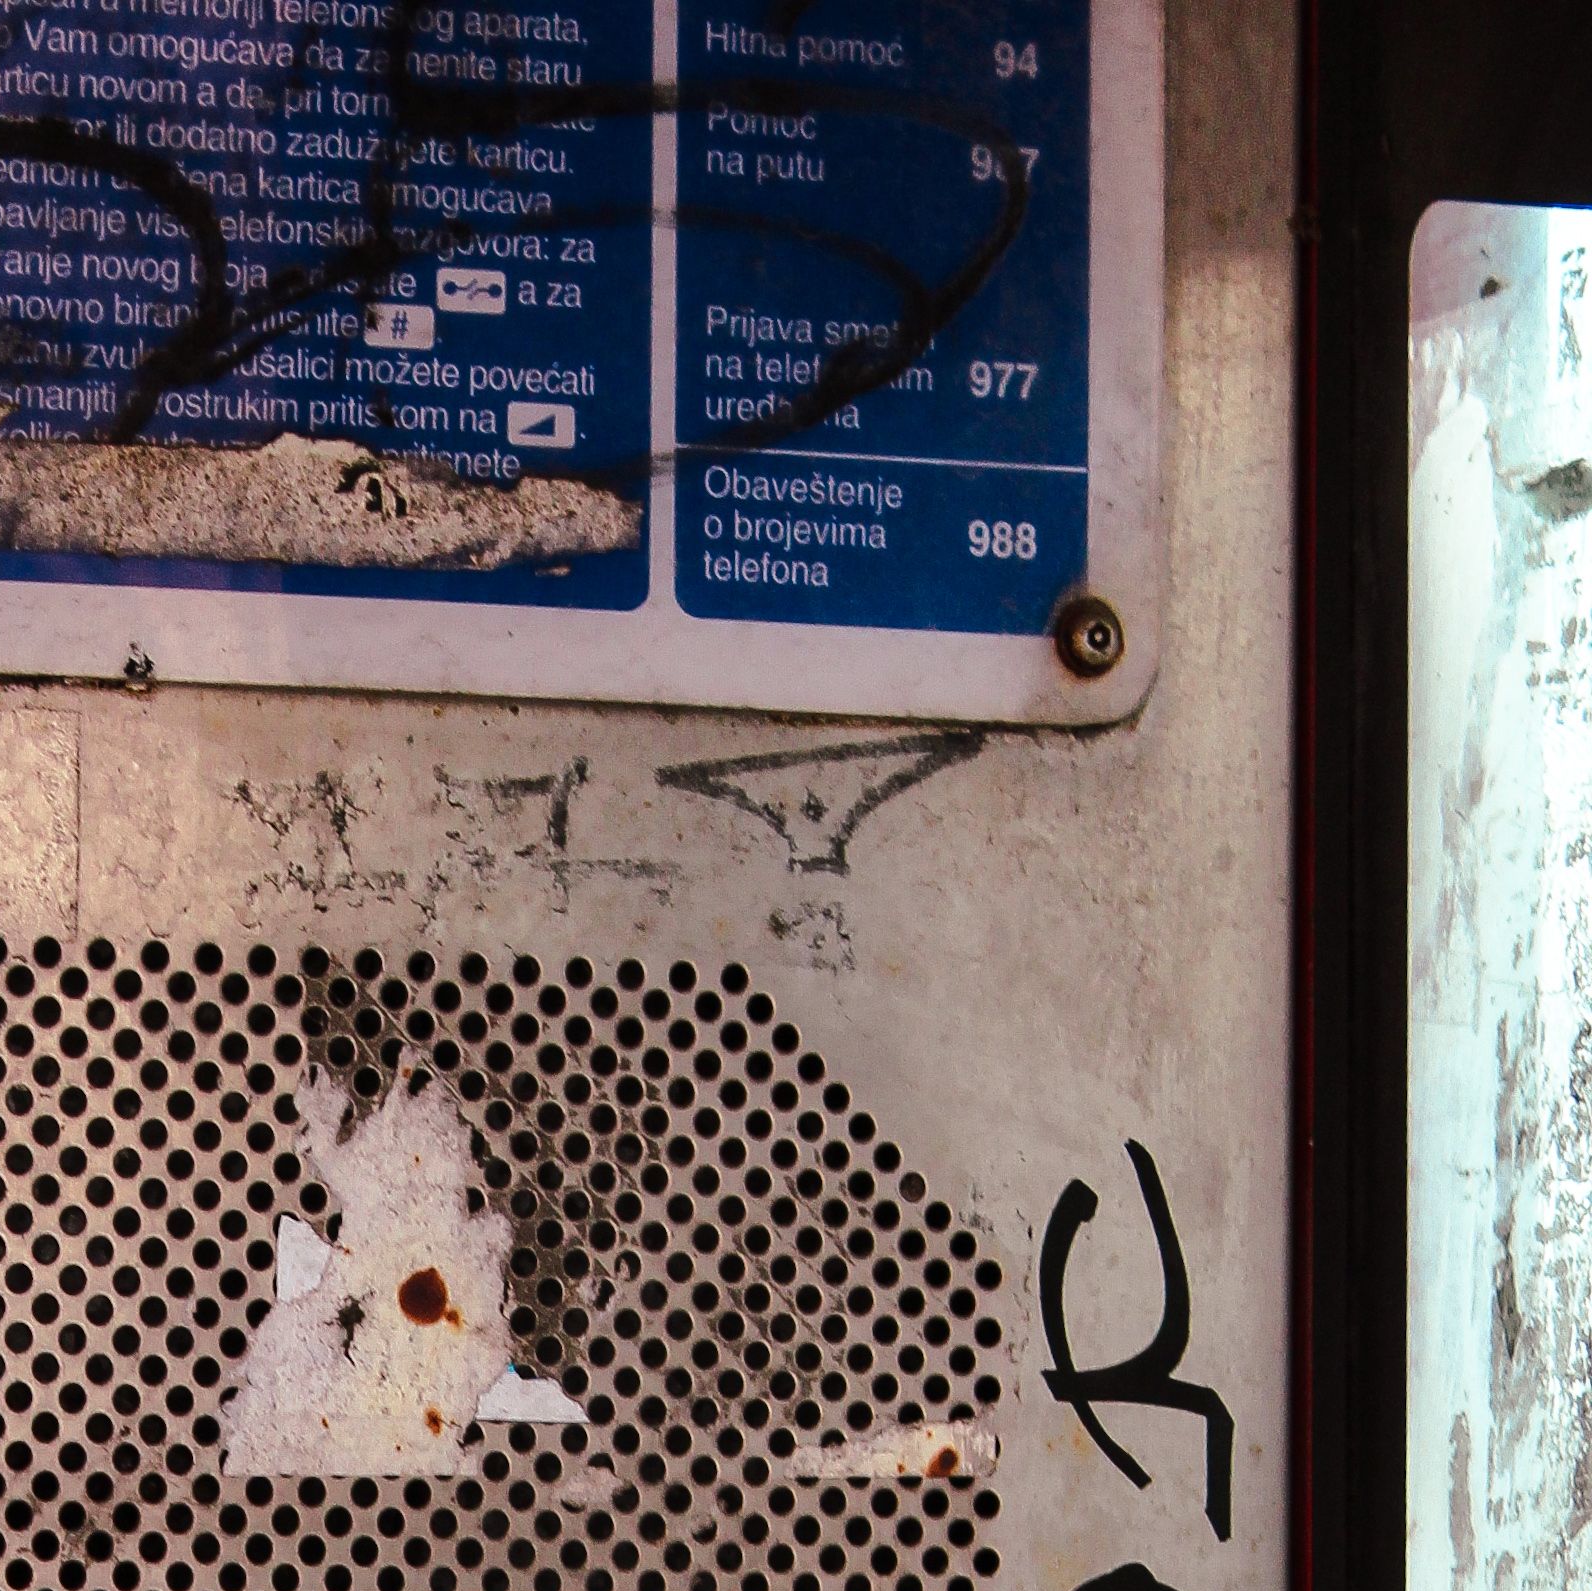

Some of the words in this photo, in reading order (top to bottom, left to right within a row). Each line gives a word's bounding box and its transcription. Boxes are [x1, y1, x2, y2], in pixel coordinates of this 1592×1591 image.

[274, 0, 454, 42] telefonsog
[465, 13, 588, 46] aparata,
[24, 20, 97, 54] Vam
[109, 31, 294, 70] omogućava
[306, 40, 344, 70] da
[507, 53, 581, 86] staru
[706, 23, 786, 57] Hitna
[799, 30, 904, 68] pomoć
[994, 41, 1038, 79] 94
[79, 75, 186, 102] novom
[197, 81, 215, 107] a
[284, 82, 321, 119] pri
[332, 86, 390, 116] tom
[115, 113, 136, 146] ili
[147, 119, 277, 154] dodatno
[467, 136, 573, 174] karticu.
[708, 150, 744, 176] na
[757, 155, 824, 185] putu
[971, 145, 1039, 182] 97
[258, 166, 361, 204] kartica
[372, 180, 553, 218] mogućava
[219, 210, 375, 247] elefonskih
[560, 238, 596, 263] za
[82, 252, 180, 293] novog
[518, 280, 537, 305] a
[547, 281, 583, 308] za
[706, 306, 813, 348] Prijava
[345, 352, 459, 388] možete
[470, 361, 595, 397] povećati
[706, 354, 744, 381] na
[968, 361, 1039, 399] 977
[460, 407, 497, 433] na
[704, 466, 903, 516] Obaveštenje
[704, 517, 723, 541] o
[734, 514, 887, 553] brojevima
[968, 519, 1038, 560] 988
[703, 551, 829, 587] telefona
